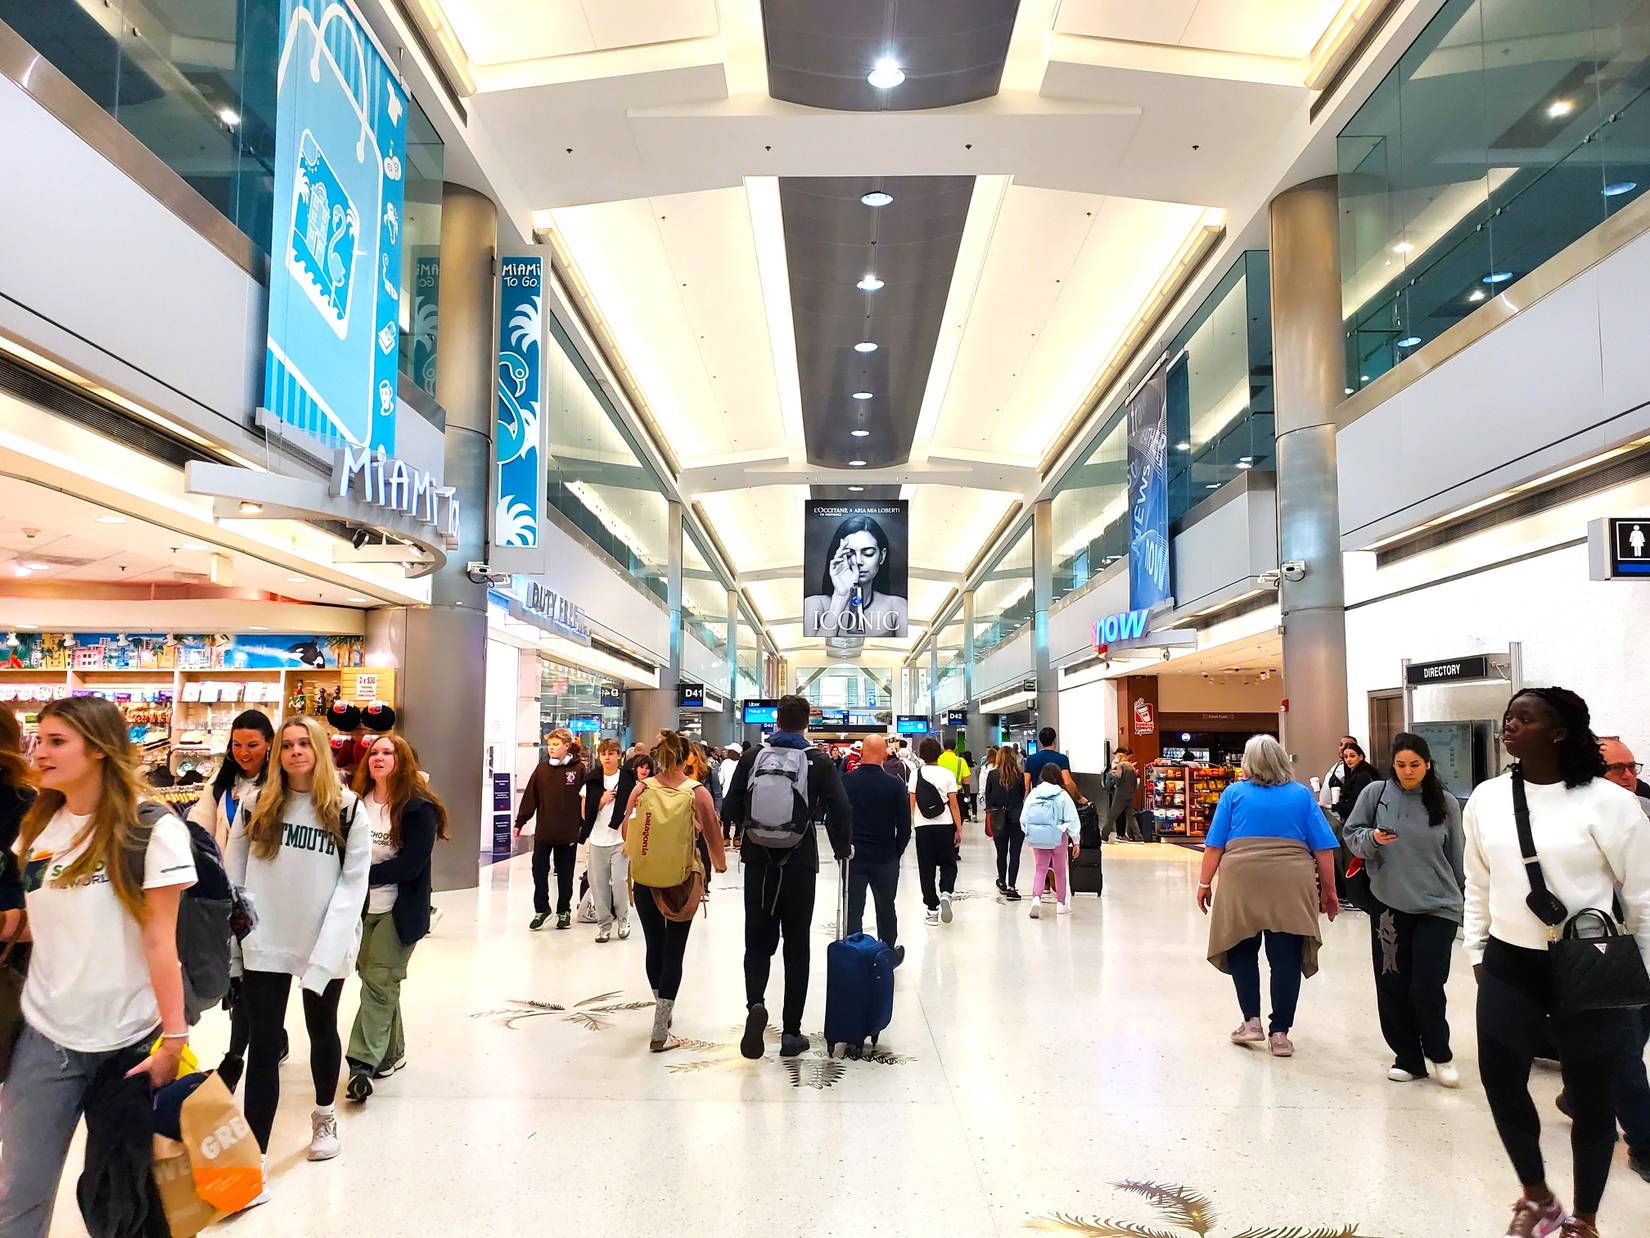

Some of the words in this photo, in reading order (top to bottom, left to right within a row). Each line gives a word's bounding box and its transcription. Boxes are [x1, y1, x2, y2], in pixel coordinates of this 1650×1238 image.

[504, 277, 518, 287] TO
[813, 610, 901, 631] ICONIC
[1423, 663, 1461, 679] DIRECTORY
[685, 688, 703, 698] D41
[281, 822, 337, 856] TMOUTH
[641, 811, 652, 857] patagonia
